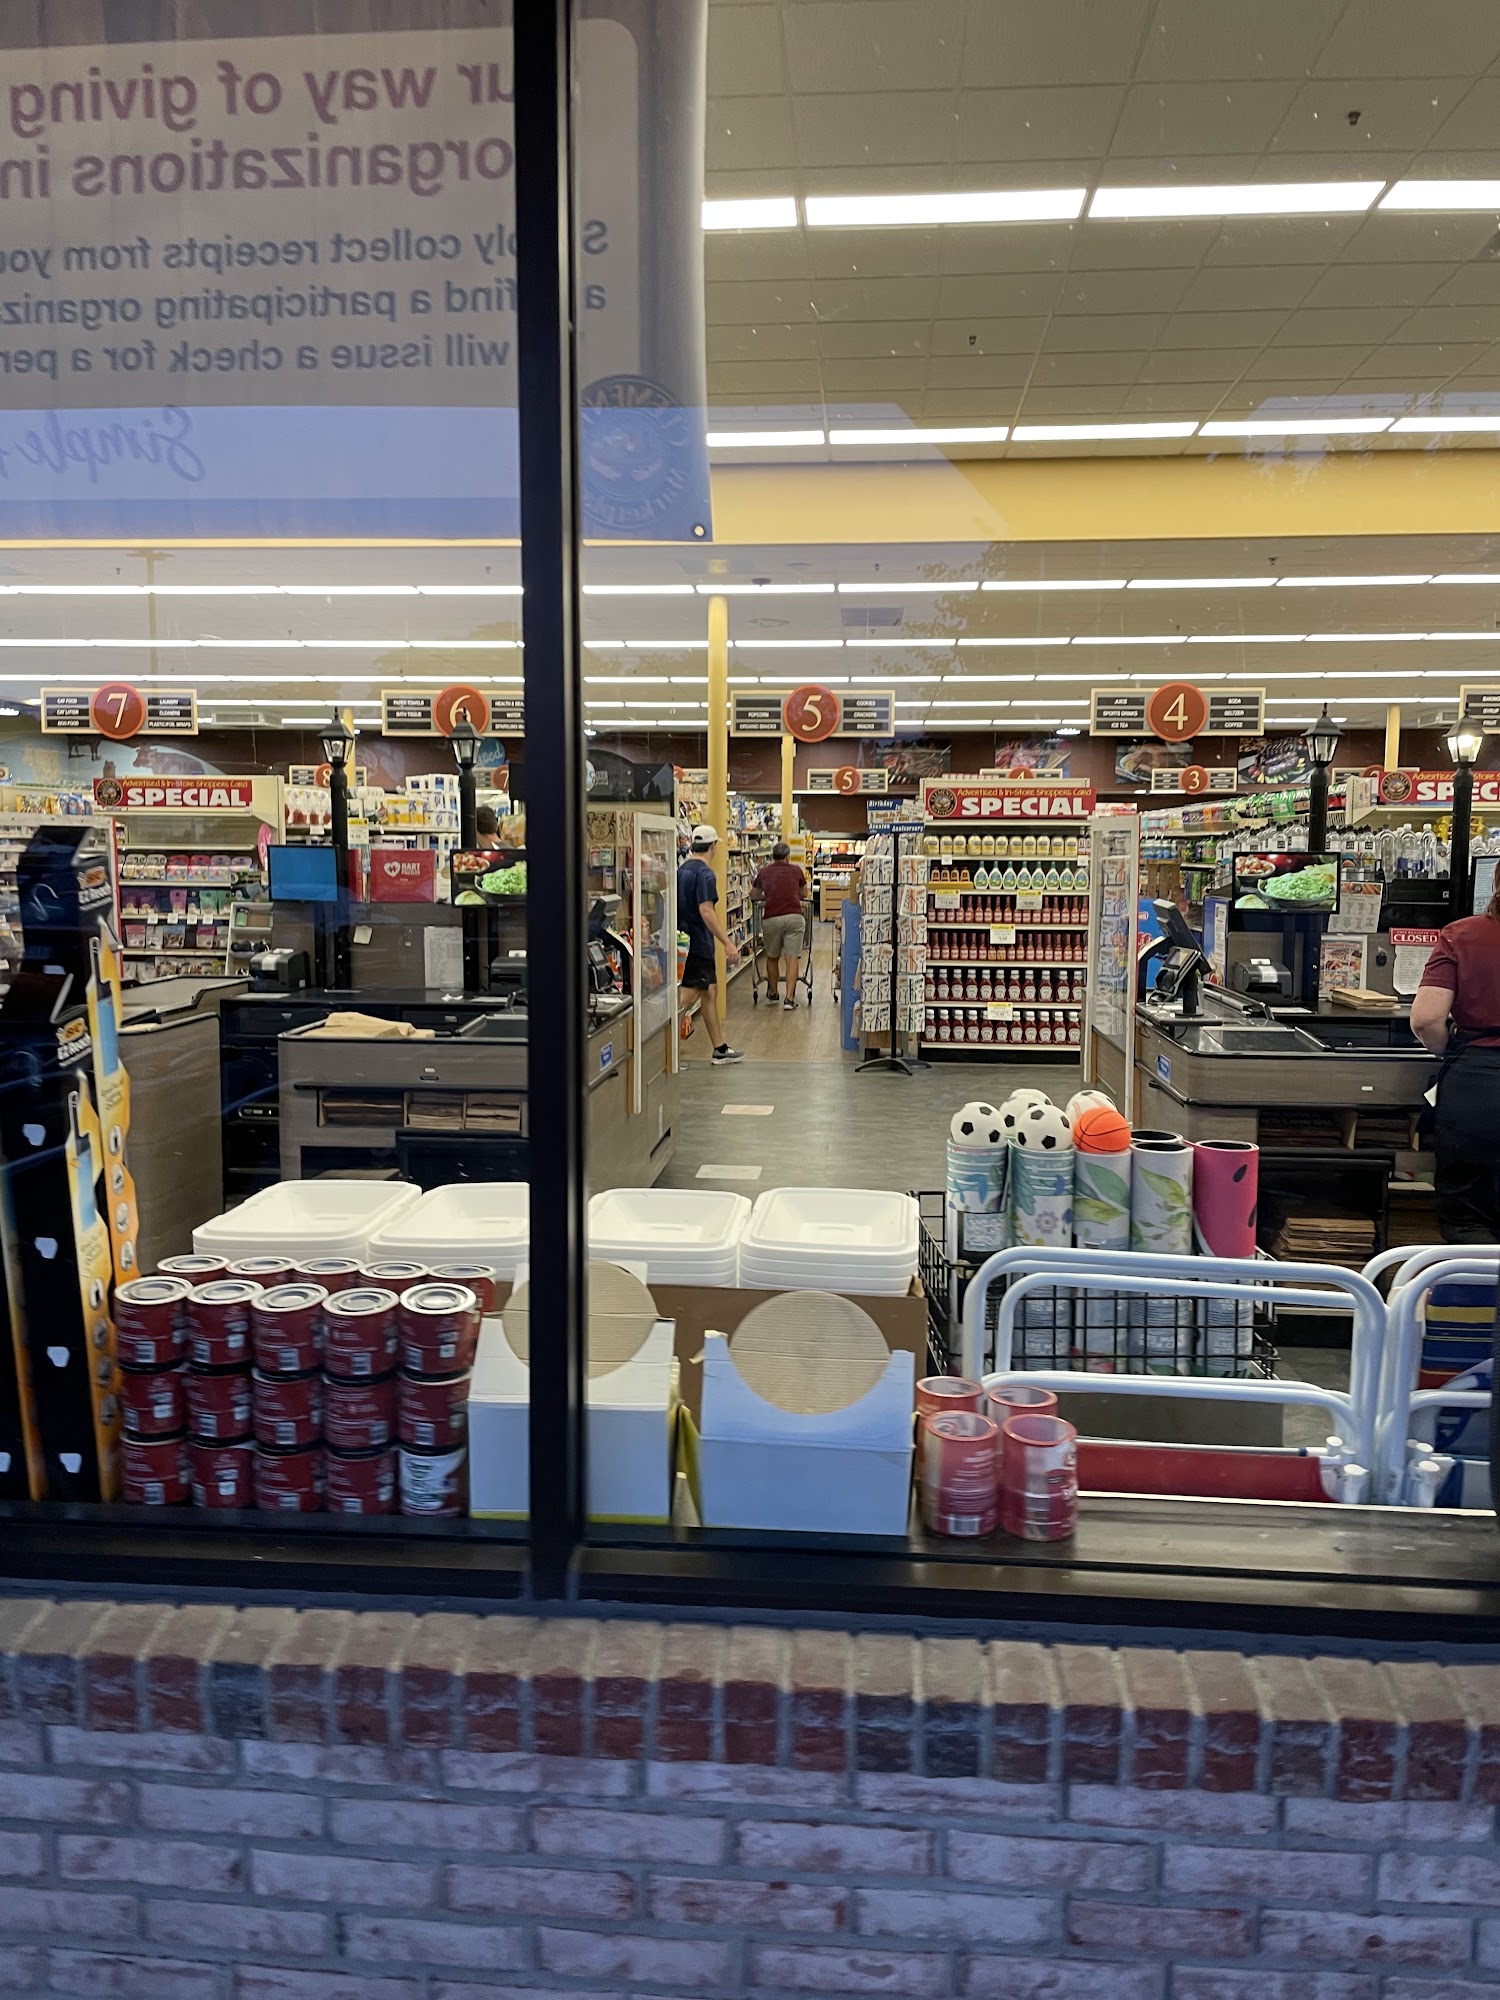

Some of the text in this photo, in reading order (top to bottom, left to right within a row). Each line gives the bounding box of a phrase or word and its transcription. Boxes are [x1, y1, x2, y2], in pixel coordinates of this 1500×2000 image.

[107, 693, 127, 729] 7
[450, 694, 472, 728] 6
[801, 694, 822, 732] 5
[1163, 693, 1189, 731] 4
[122, 779, 161, 788] Advertised
[166, 780, 194, 788] In-Store
[196, 780, 229, 789] Shoppers
[230, 780, 248, 788] Card
[322, 767, 331, 786] 8
[500, 769, 509, 788] 7
[842, 771, 853, 790] 5
[1188, 770, 1199, 789] 3
[127, 787, 246, 807] SPECIAL
[957, 788, 1092, 798] Advertised & In-Store Shoppers Card
[961, 797, 1089, 816] SPECIAL
[401, 862, 420, 871] HART
[1393, 934, 1438, 943] CLOSED
